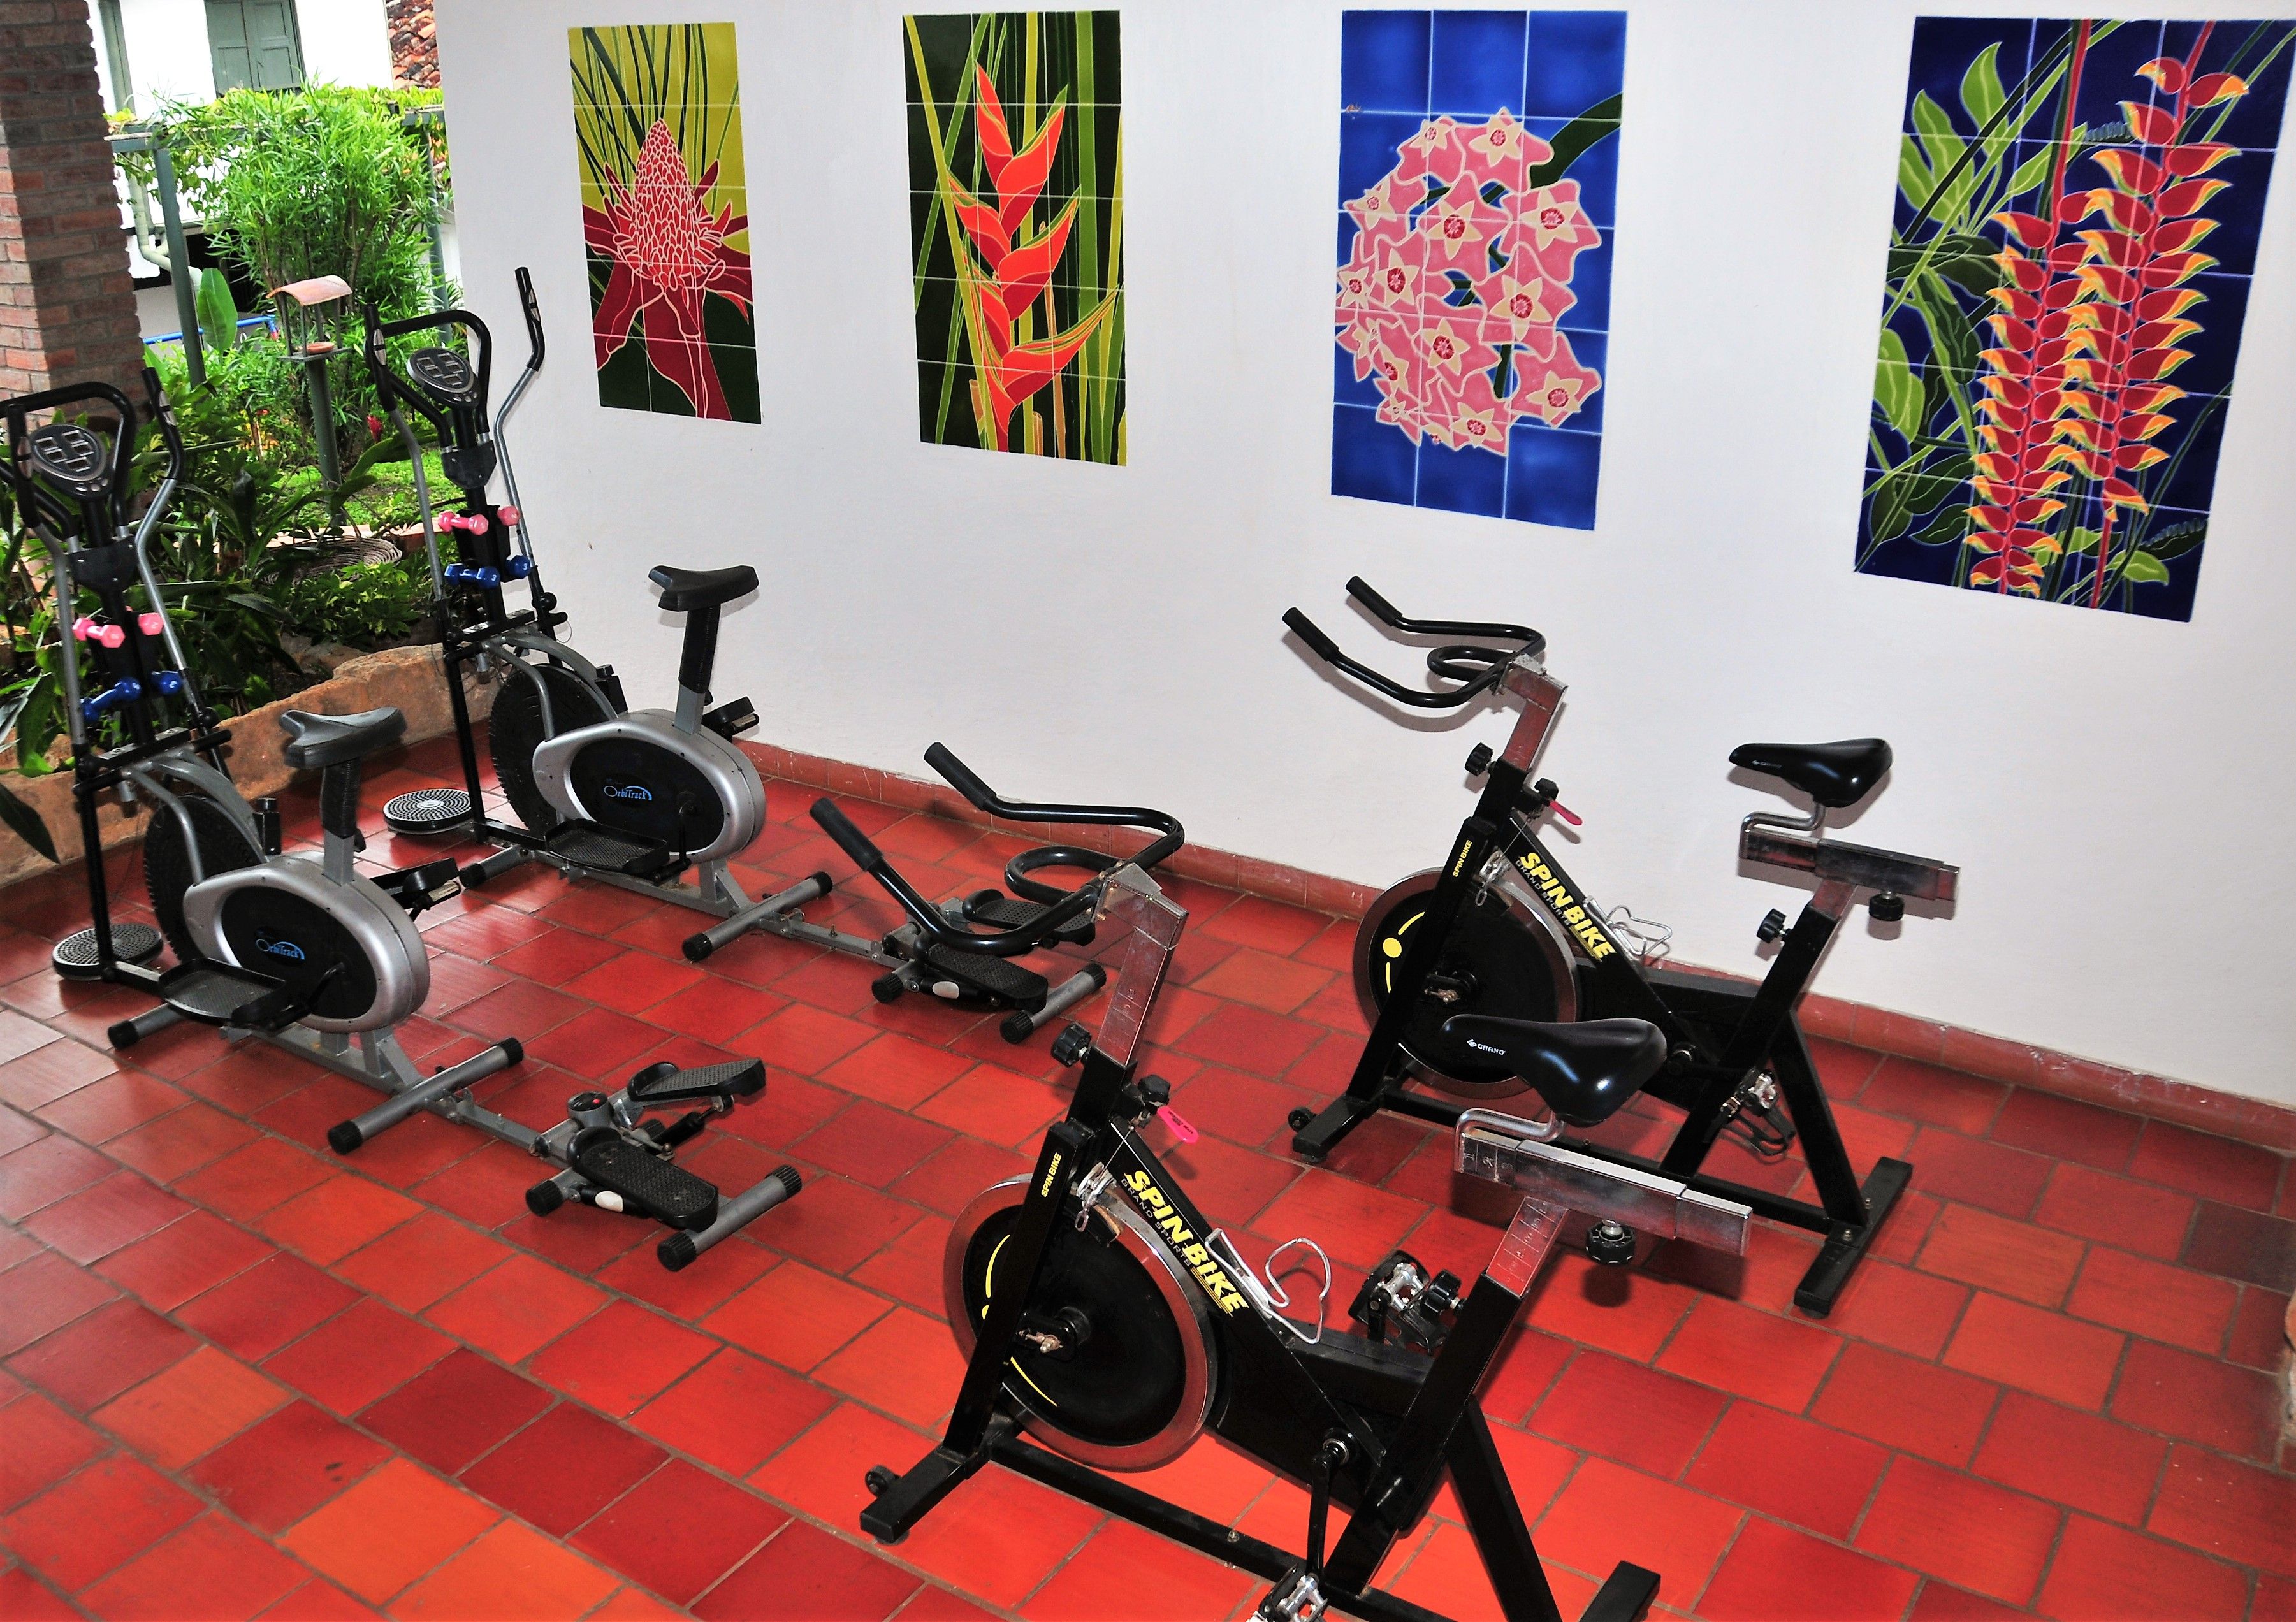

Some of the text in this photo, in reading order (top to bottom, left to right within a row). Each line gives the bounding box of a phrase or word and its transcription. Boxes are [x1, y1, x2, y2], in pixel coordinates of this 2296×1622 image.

[604, 785, 647, 800] OrbiTrack
[1452, 839, 1472, 877] SPIN BIKE
[1515, 860, 1571, 925] GRAND SPORTS
[1518, 852, 1574, 908] SPIN
[1564, 905, 1617, 959] BIKE
[1477, 1043, 1505, 1055] GRAND
[1041, 1152, 1062, 1197] SPIN BIKE
[1121, 1178, 1191, 1266] GRAND SPORTS
[1124, 1170, 1249, 1313] SPIN BIKE
